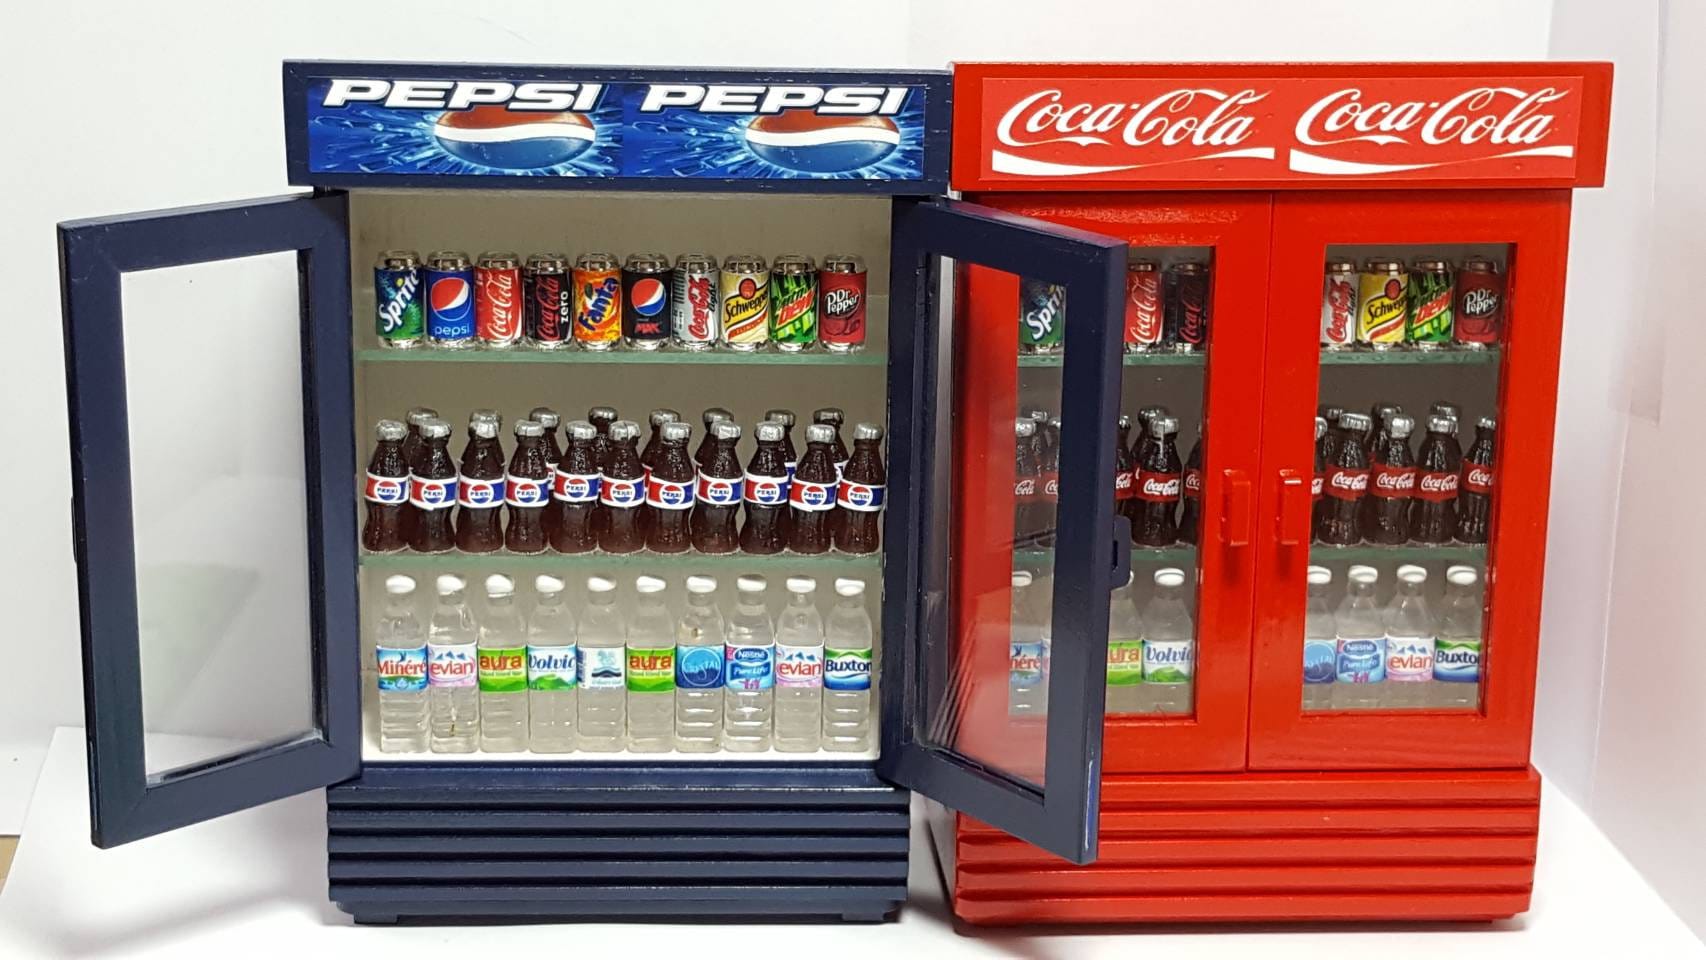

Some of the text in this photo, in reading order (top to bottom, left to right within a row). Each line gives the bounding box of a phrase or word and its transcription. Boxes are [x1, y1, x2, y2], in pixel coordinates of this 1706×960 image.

[322, 78, 604, 113] PEPSI
[639, 83, 910, 115] PEPSI
[996, 89, 1274, 147] Coca-Cola
[1294, 87, 1574, 147] Coca-Cola
[836, 289, 851, 302] Dr
[1477, 288, 1491, 302] Dr
[560, 291, 569, 323] zero
[578, 277, 618, 331] Fanta
[824, 292, 860, 315] Pepper
[434, 323, 470, 337] pepsi
[528, 654, 576, 669] Volvic
[1108, 646, 1140, 663] ura
[1390, 654, 1433, 669] evian
[1436, 650, 1480, 665] Buxto
[430, 661, 474, 675] evian
[480, 655, 522, 670] aura
[630, 655, 672, 670] aura
[780, 661, 821, 676] evian
